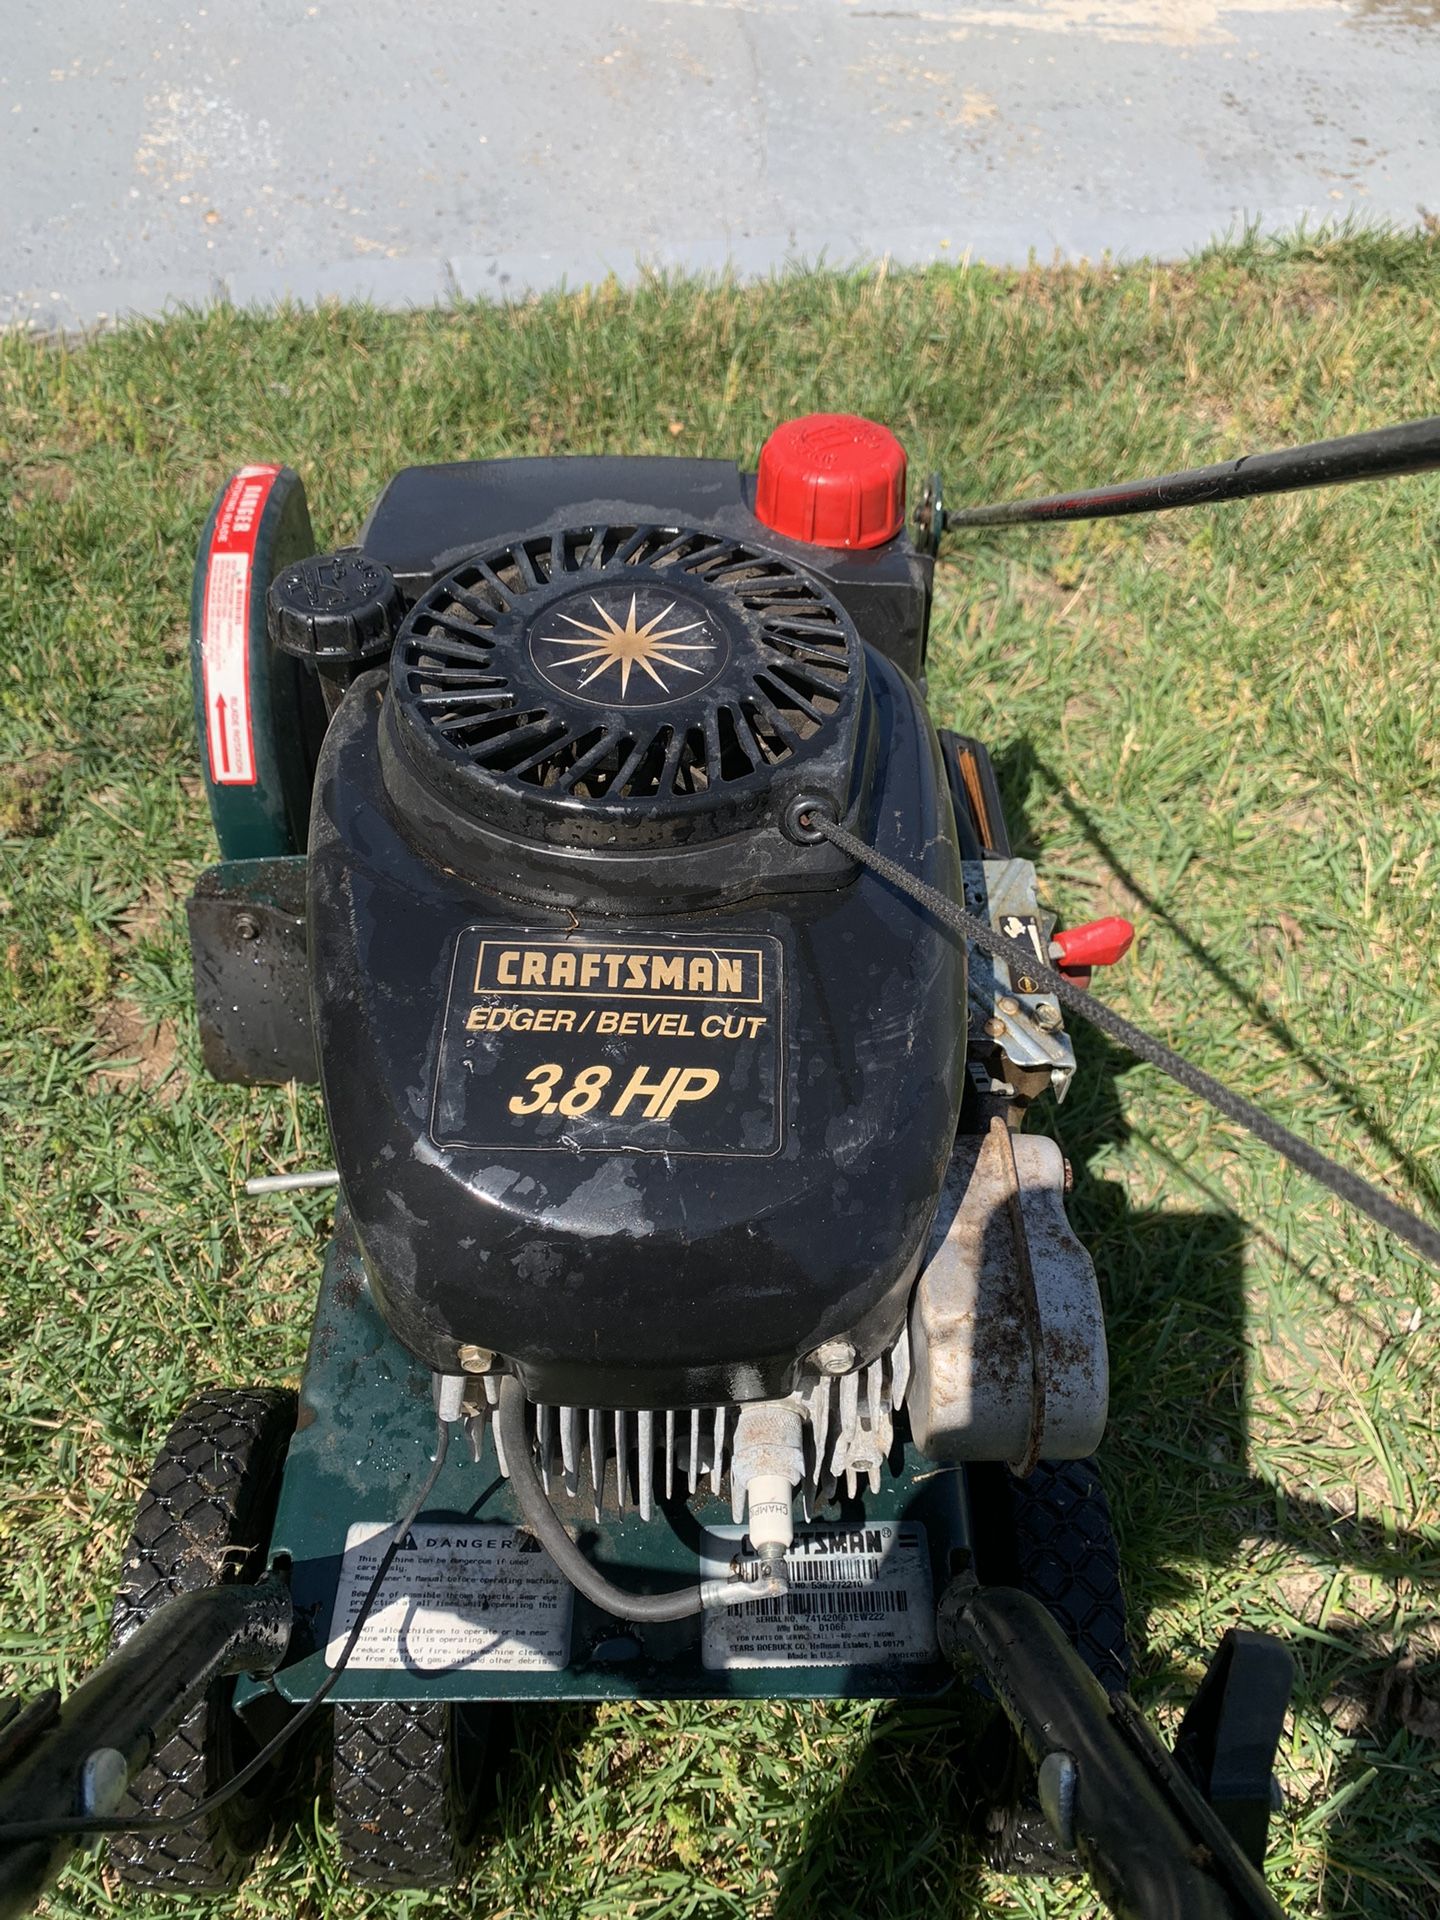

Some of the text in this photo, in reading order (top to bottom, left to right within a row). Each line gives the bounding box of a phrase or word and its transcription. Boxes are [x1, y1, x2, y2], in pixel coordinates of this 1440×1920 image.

[496, 951, 743, 993] CRAFTSMAN
[700, 1015, 767, 1039] CUT
[508, 1063, 720, 1118] 3.8 HP
[426, 1538, 513, 1549] DANGER
[359, 1555, 378, 1563] This
[480, 1577, 523, 1586] operating
[388, 1591, 399, 1599] of
[445, 1592, 474, 1600] thrown
[542, 1594, 558, 1602] eye
[490, 1601, 534, 1610] operating
[538, 1601, 558, 1609] this
[756, 1615, 782, 1624] SERIAL
[407, 1627, 447, 1635] children
[450, 1627, 460, 1635] to
[463, 1628, 498, 1637] operate
[411, 1635, 421, 1643] it
[440, 1636, 486, 1644] operating.
[751, 1633, 773, 1641] PARTS
[729, 1643, 755, 1652] SEARS
[757, 1642, 793, 1652] ROEBUCK
[456, 1648, 476, 1657] keep
[787, 1651, 808, 1660] Made
[365, 1655, 385, 1663] from
[389, 1656, 423, 1664] spilled
[489, 1657, 513, 1665] other
